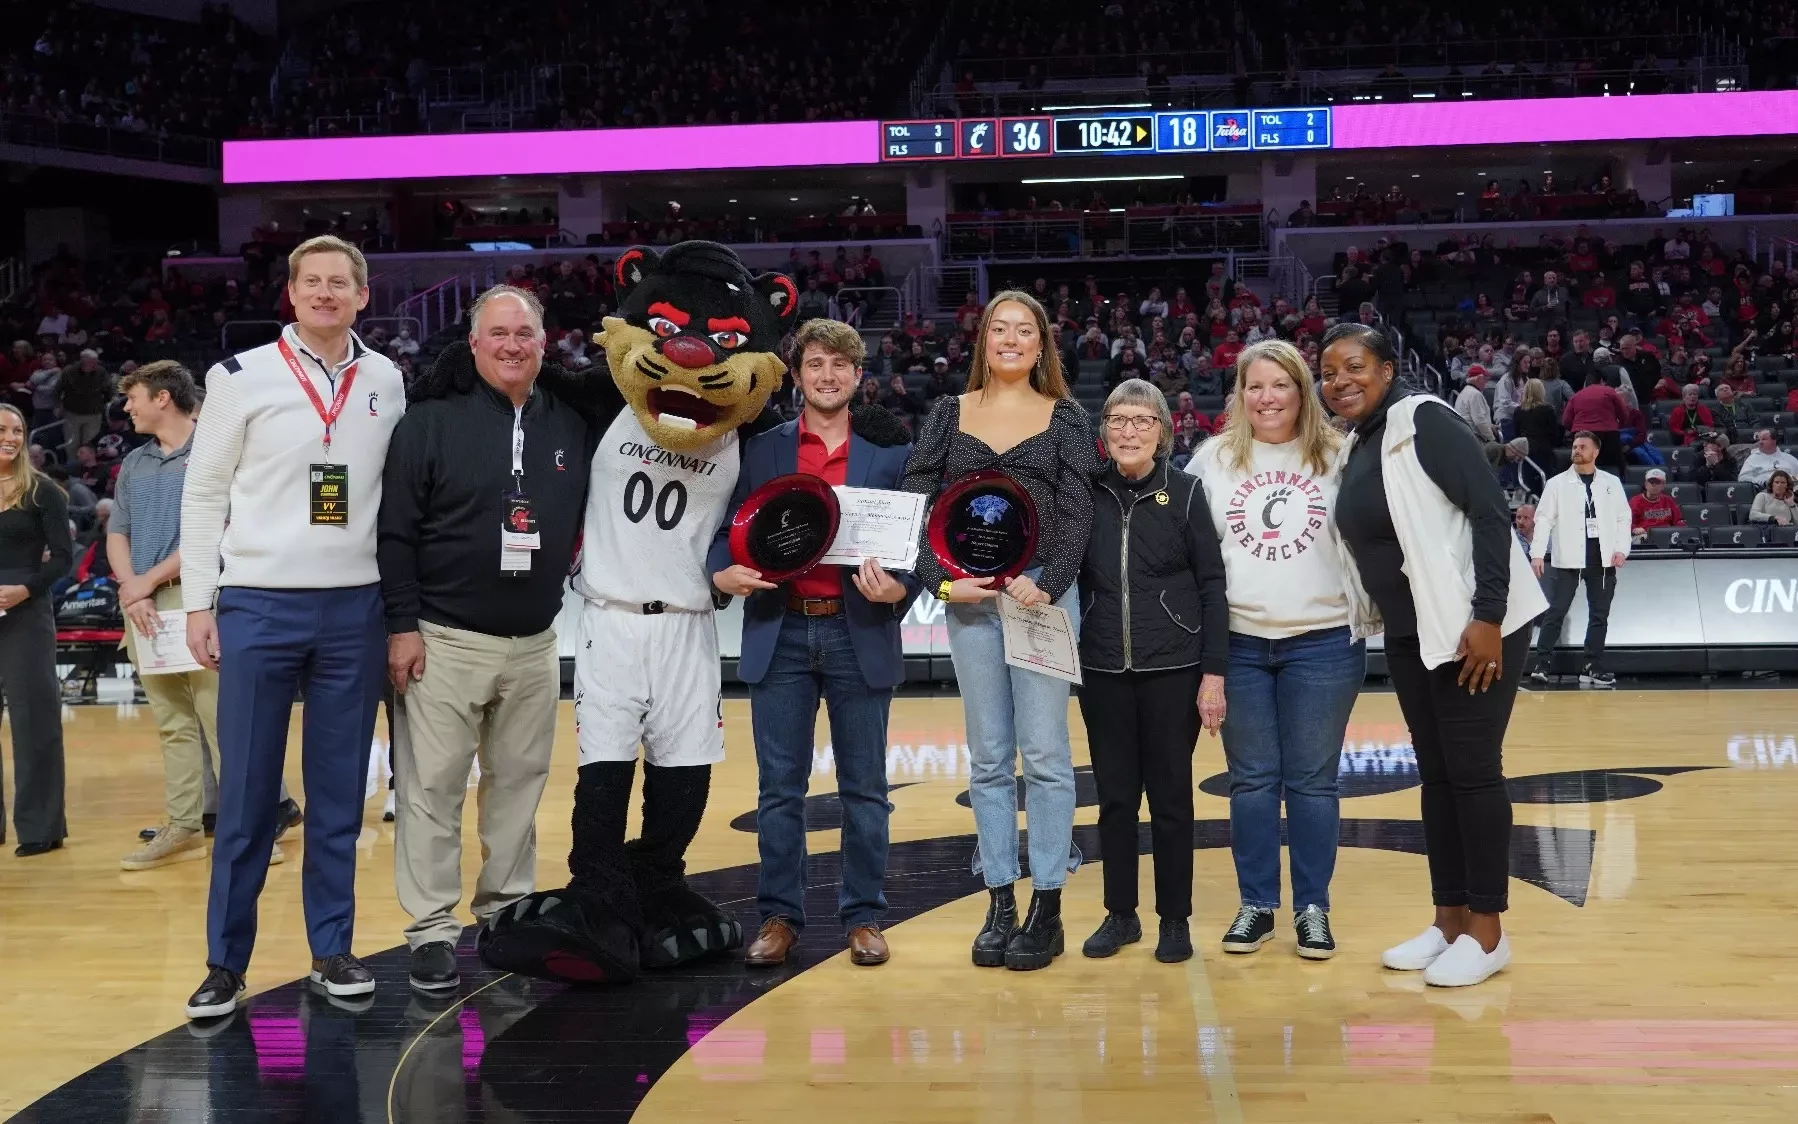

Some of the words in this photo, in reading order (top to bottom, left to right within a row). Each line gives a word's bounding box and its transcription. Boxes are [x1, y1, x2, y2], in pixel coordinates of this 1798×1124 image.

[889, 126, 910, 137] TOL
[934, 124, 942, 137] 3
[1169, 117, 1197, 147] 18
[1213, 124, 1248, 137] Tulsa
[1260, 115, 1282, 125] TOL
[1307, 113, 1314, 125] 2
[1012, 122, 1041, 152] 36
[1078, 121, 1132, 147] 10:42
[1261, 133, 1279, 144] FLS
[1307, 130, 1314, 143] 0
[889, 144, 908, 156] FLS
[934, 142, 942, 154] 0
[618, 441, 718, 476] CINCINNATI
[320, 484, 339, 493] JOHN
[623, 470, 688, 531] 00
[1229, 470, 1324, 508] CINCINNATI
[1230, 516, 1322, 562] BEARCATS
[60, 597, 107, 611] Ameritas
[1724, 578, 1798, 614] CIN
